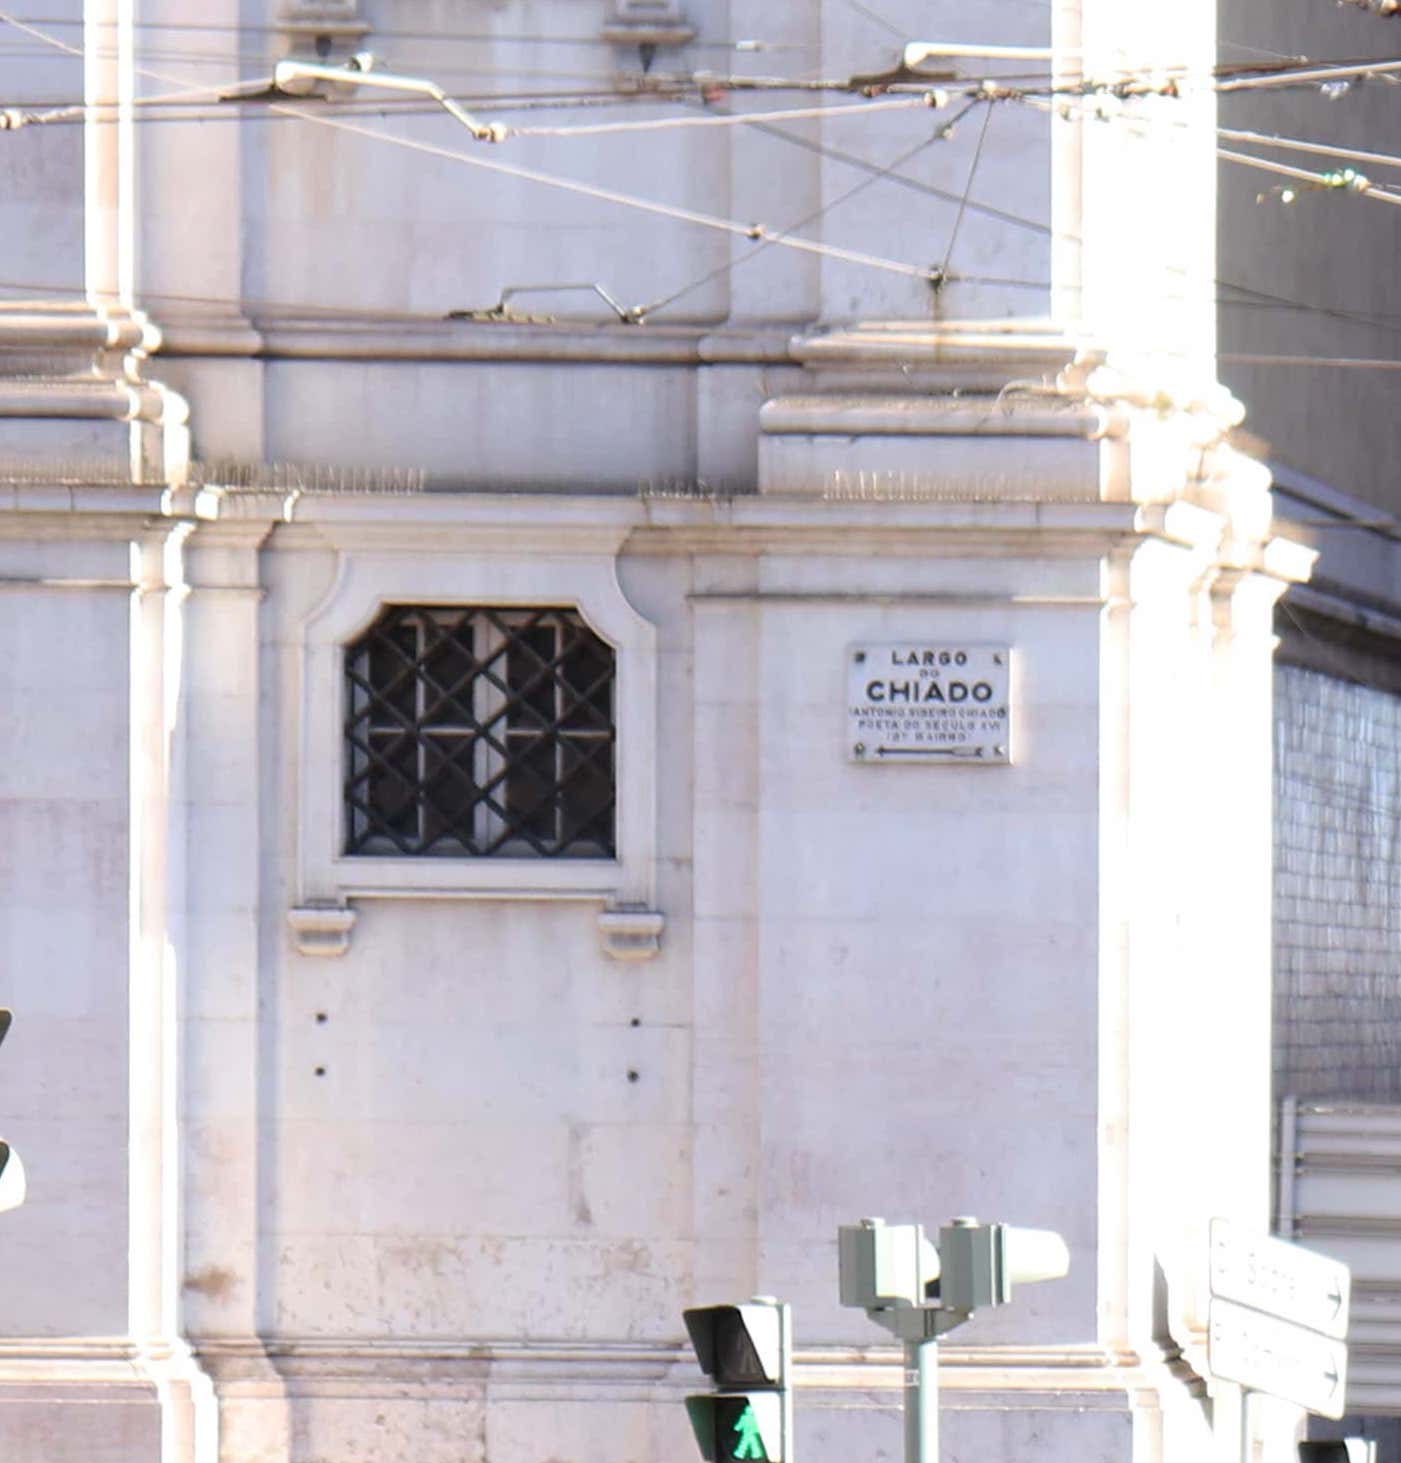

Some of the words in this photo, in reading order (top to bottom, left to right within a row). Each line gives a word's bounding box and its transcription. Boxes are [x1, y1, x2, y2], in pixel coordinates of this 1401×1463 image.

[891, 650, 968, 666] LARGO
[919, 668, 940, 678] DO
[866, 680, 993, 702] CHIADO
